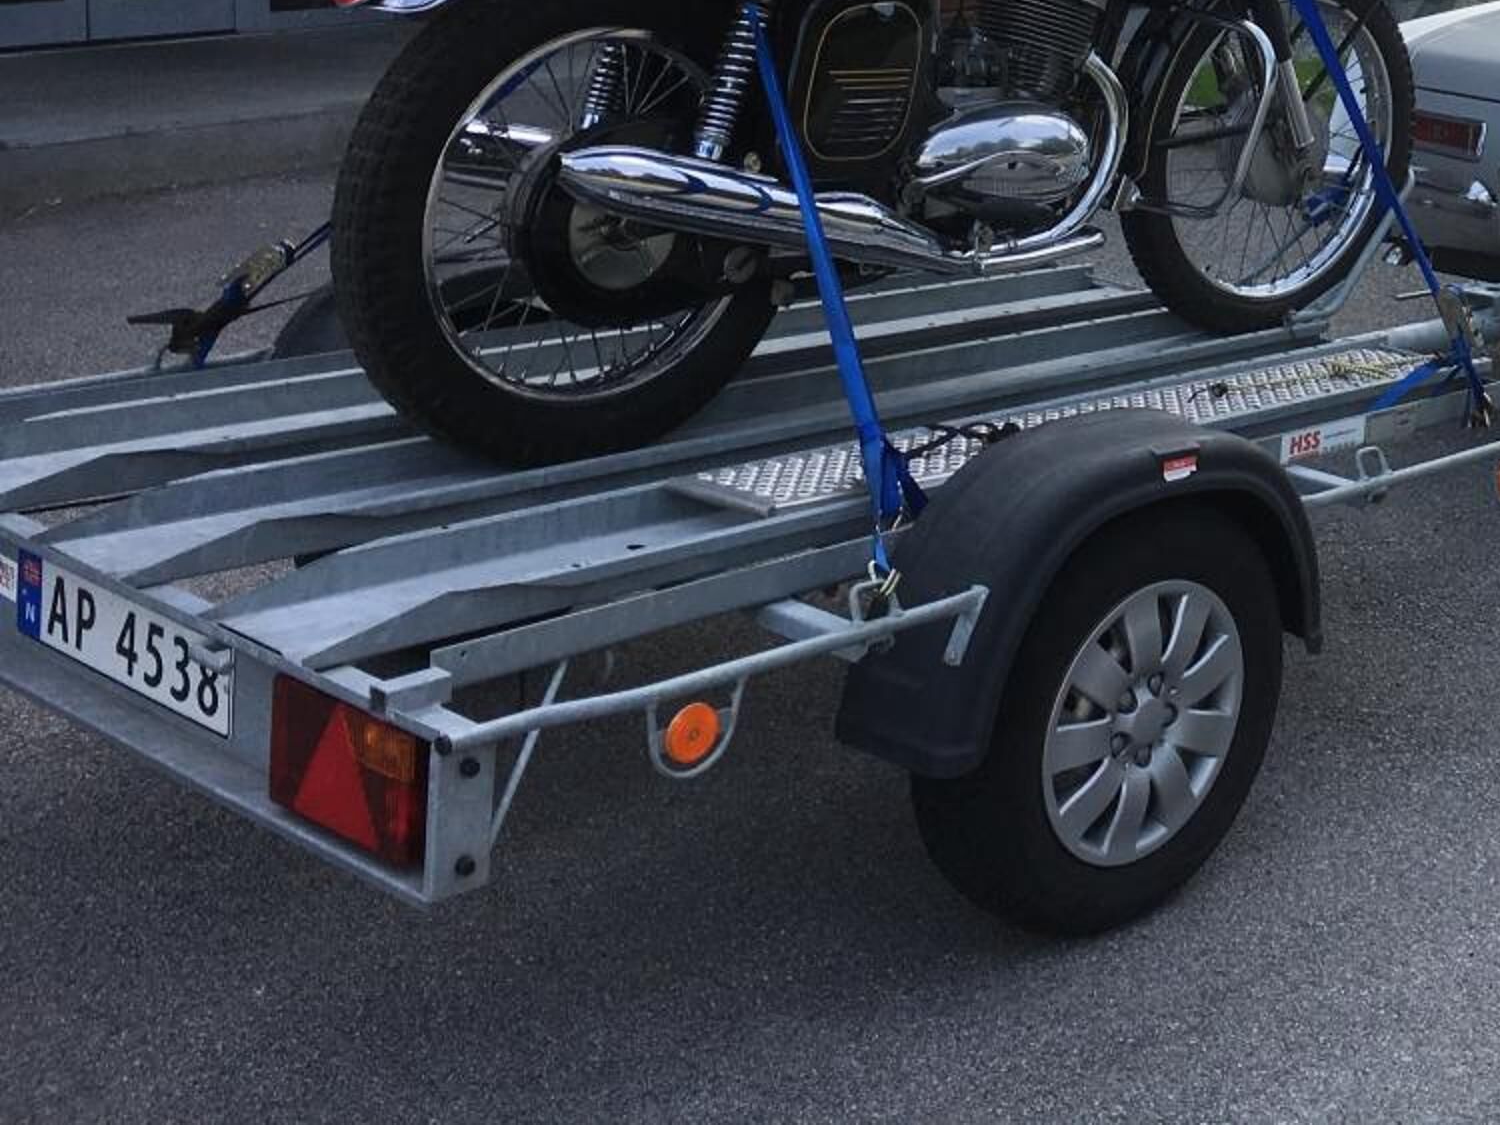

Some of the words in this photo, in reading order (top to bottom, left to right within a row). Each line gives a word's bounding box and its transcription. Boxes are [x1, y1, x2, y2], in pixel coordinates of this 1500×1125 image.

[1289, 429, 1321, 456] HSS
[25, 602, 36, 625] N
[47, 577, 96, 651] AP
[116, 612, 219, 717] 4538
